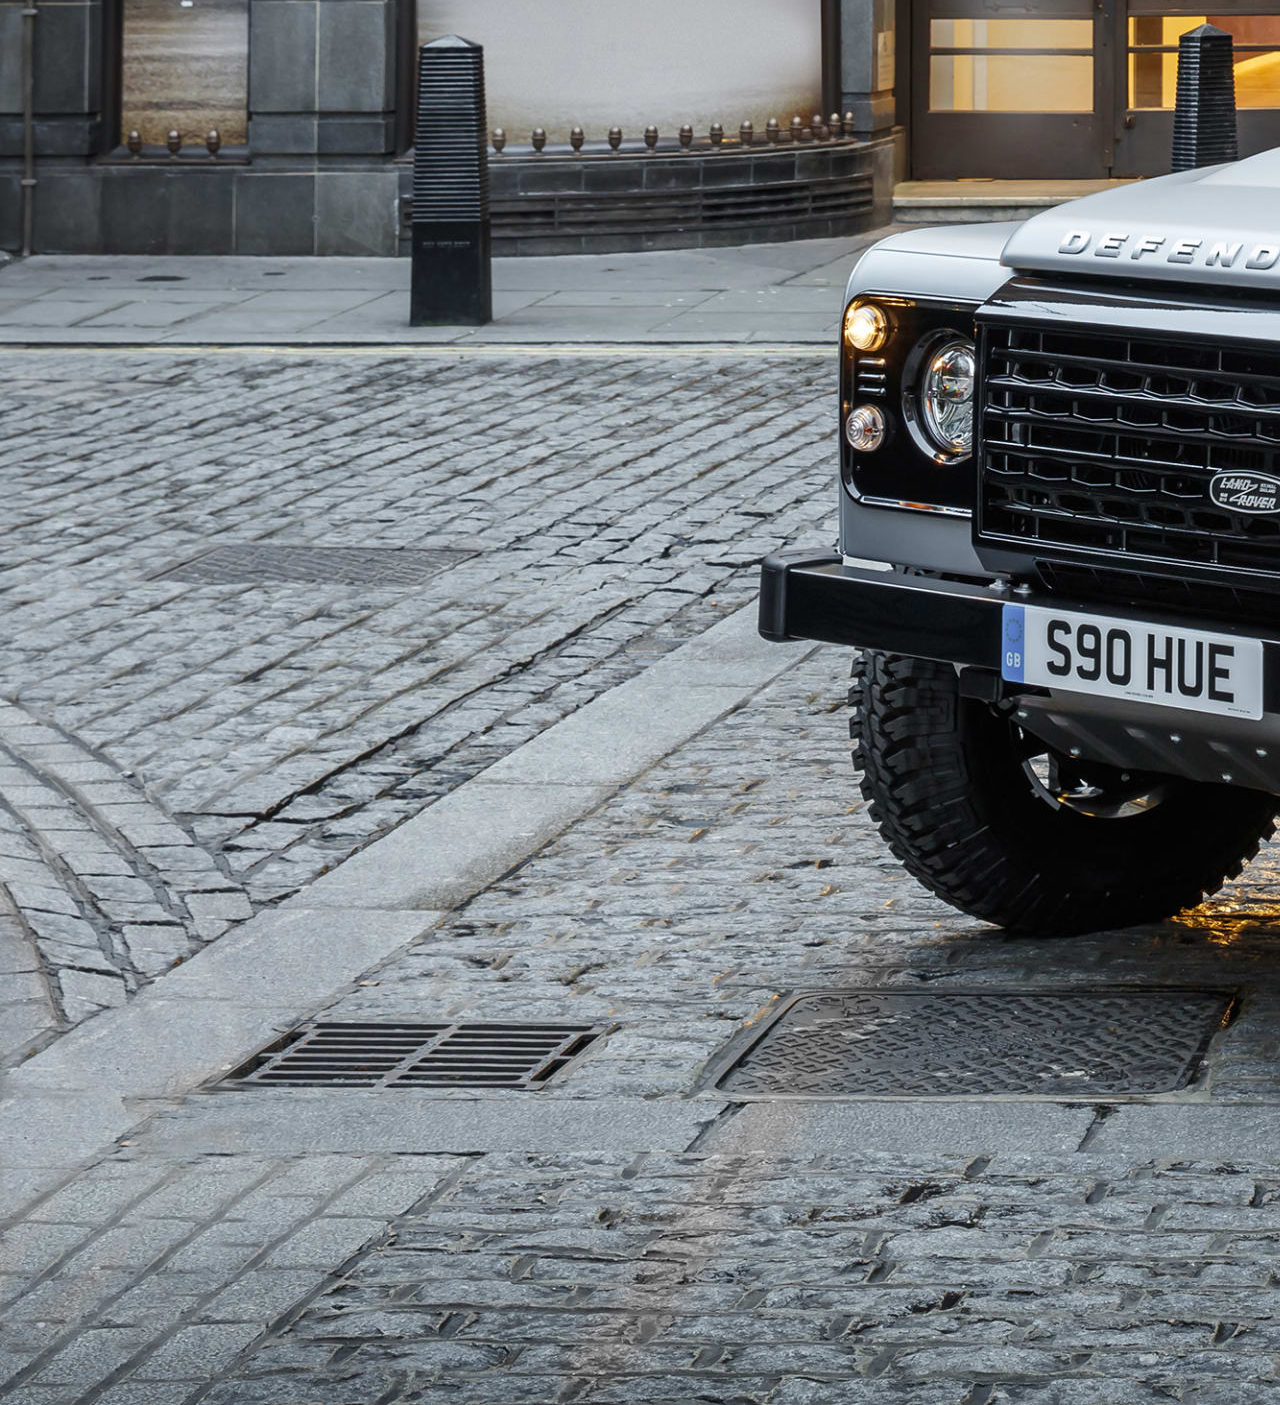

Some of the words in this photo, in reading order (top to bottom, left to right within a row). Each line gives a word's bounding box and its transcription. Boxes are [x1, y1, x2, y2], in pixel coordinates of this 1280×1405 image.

[1220, 478, 1251, 490] LAND
[1238, 495, 1277, 509] ROVER
[1006, 651, 1021, 668] GB
[1046, 619, 1132, 686] S90
[1146, 633, 1235, 704] HUE
